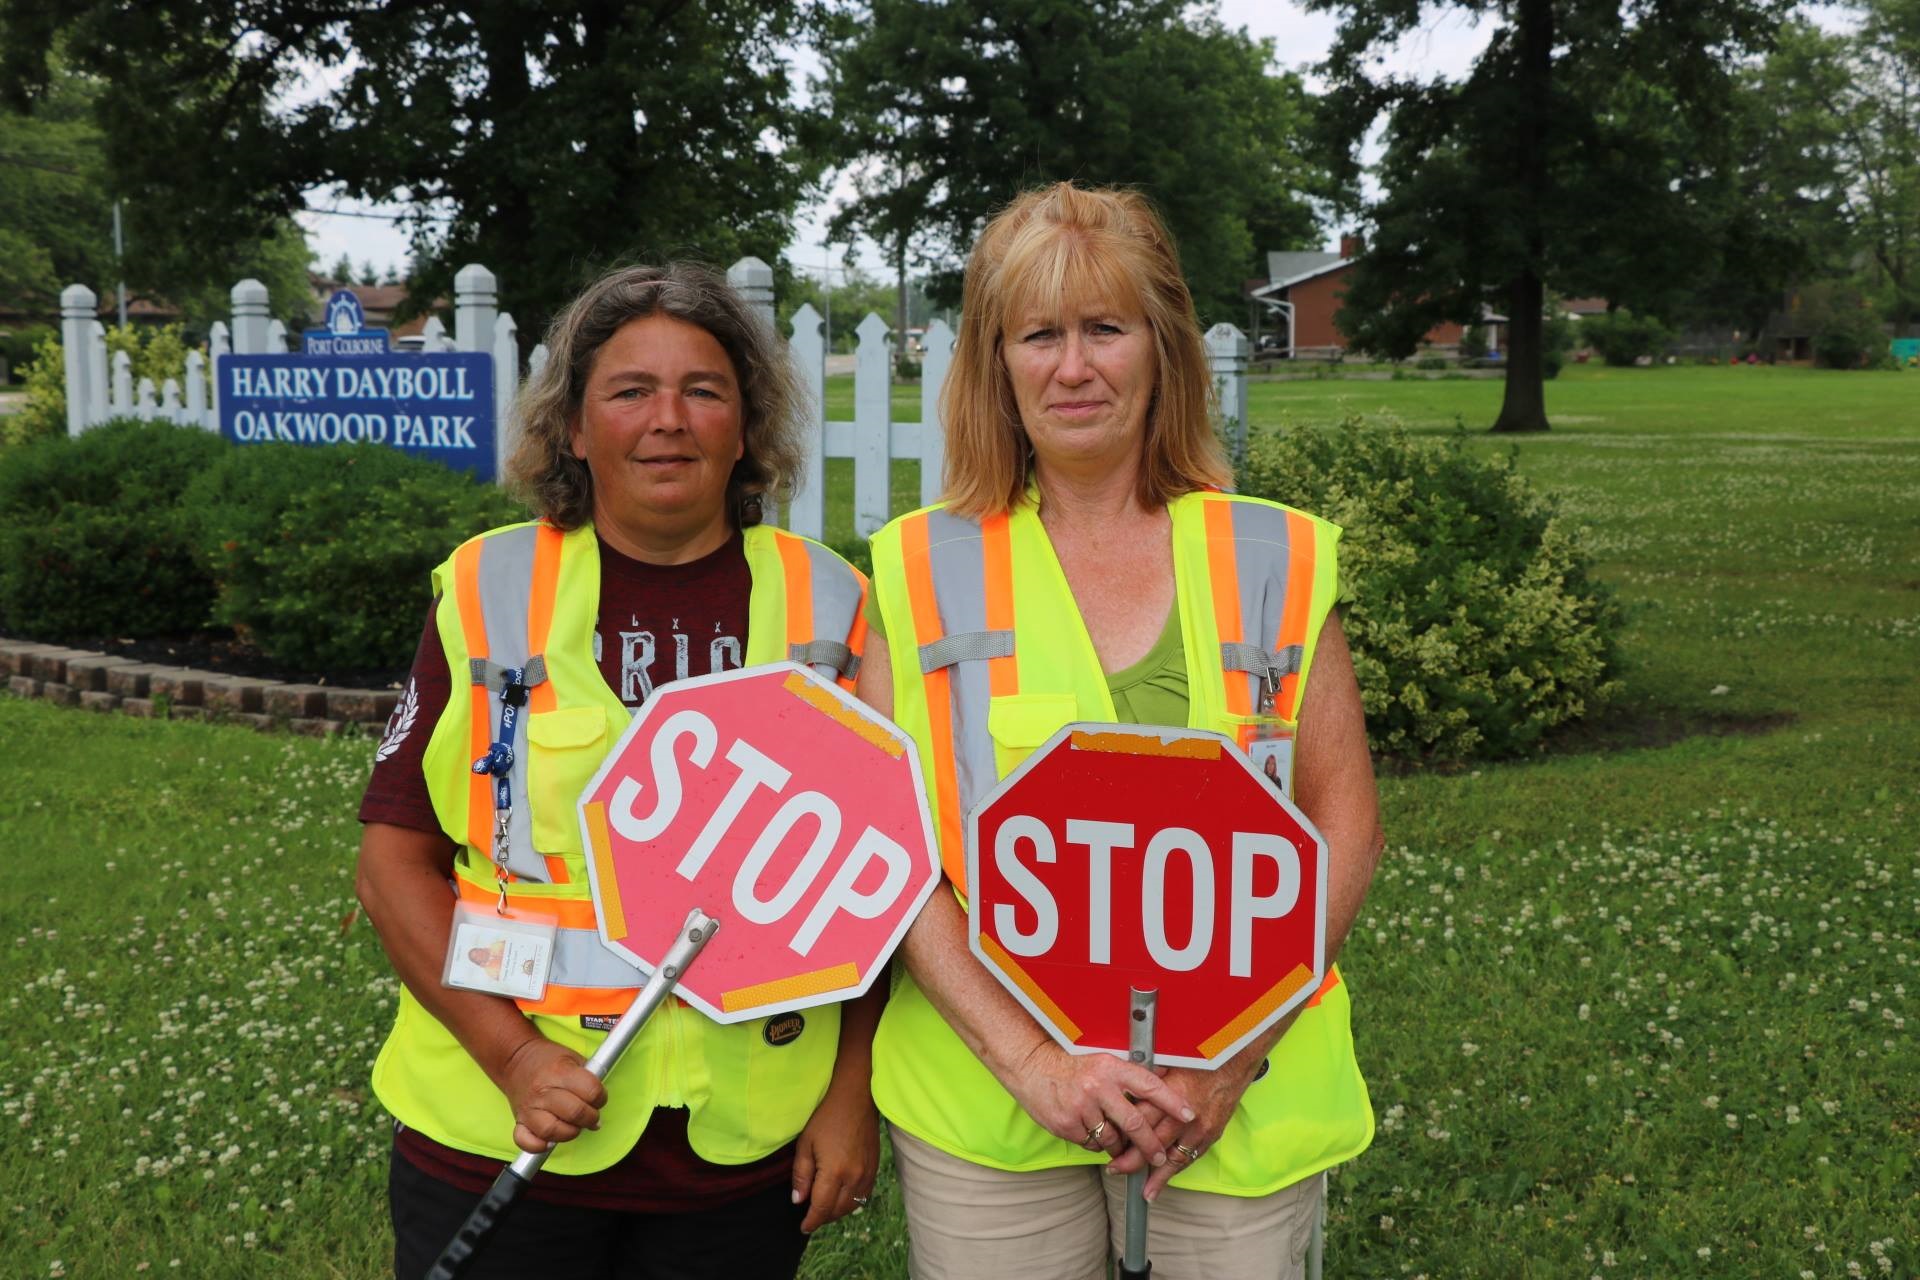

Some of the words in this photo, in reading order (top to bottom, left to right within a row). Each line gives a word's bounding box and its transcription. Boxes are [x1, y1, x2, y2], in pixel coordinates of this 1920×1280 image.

[307, 337, 331, 355] PORT
[333, 337, 384, 355] COLBORNE
[231, 367, 330, 398] HARRY
[336, 367, 475, 399] DAYBOLL
[234, 411, 388, 444] OAKWOOD
[393, 415, 477, 448] PARK
[608, 710, 912, 958] STOP
[993, 815, 1301, 978] STOP
